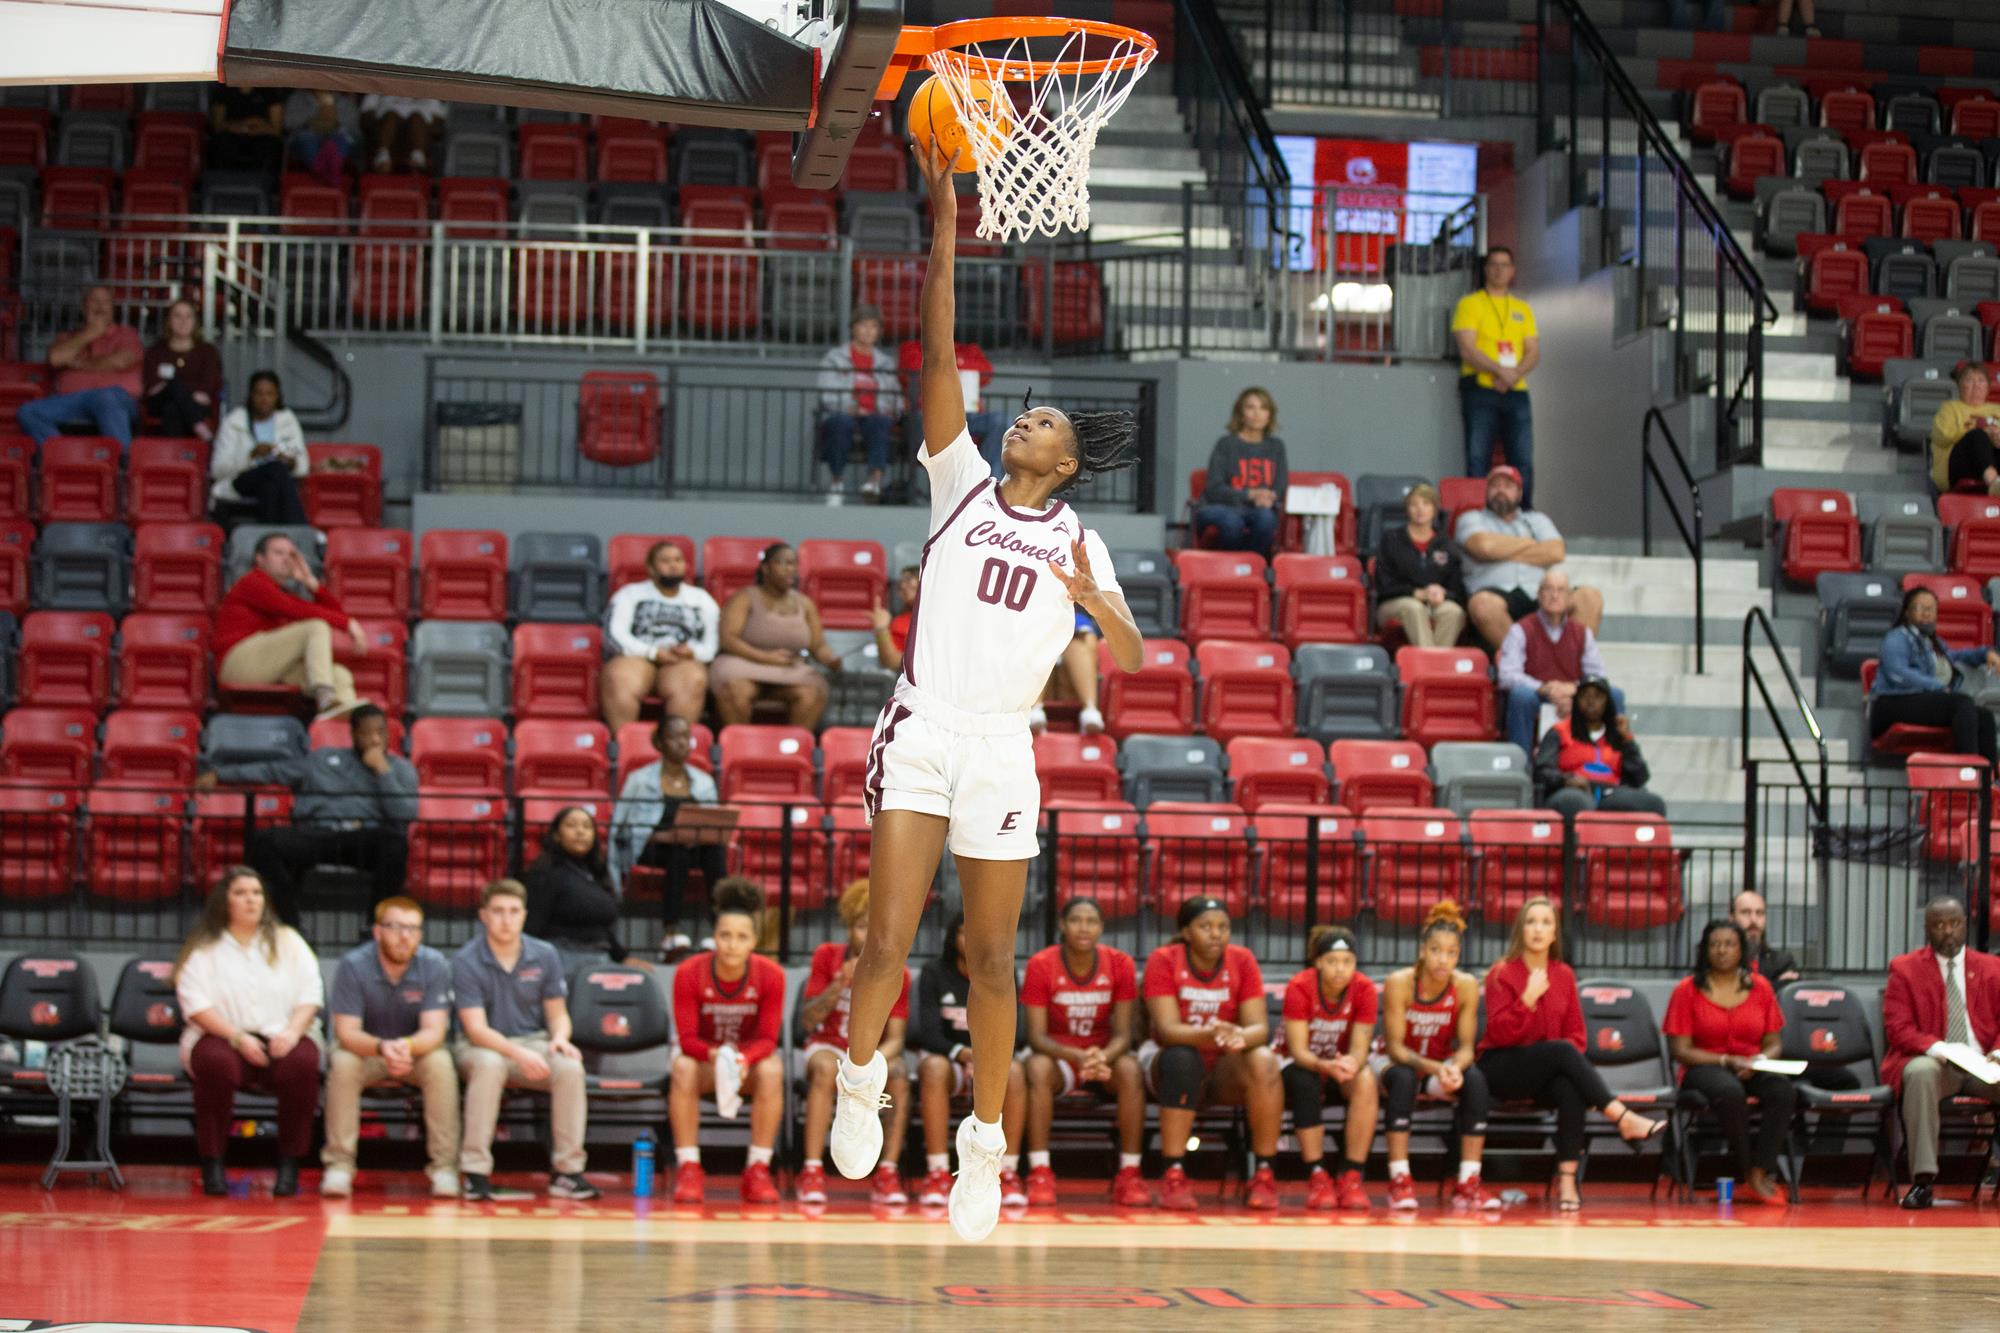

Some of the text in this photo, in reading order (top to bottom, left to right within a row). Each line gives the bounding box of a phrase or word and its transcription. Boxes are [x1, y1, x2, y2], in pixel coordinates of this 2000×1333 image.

[964, 520, 1067, 567] Colonels
[976, 556, 1038, 612] 00
[999, 810, 1022, 832] E
[652, 1282, 1712, 1311] ASUN
